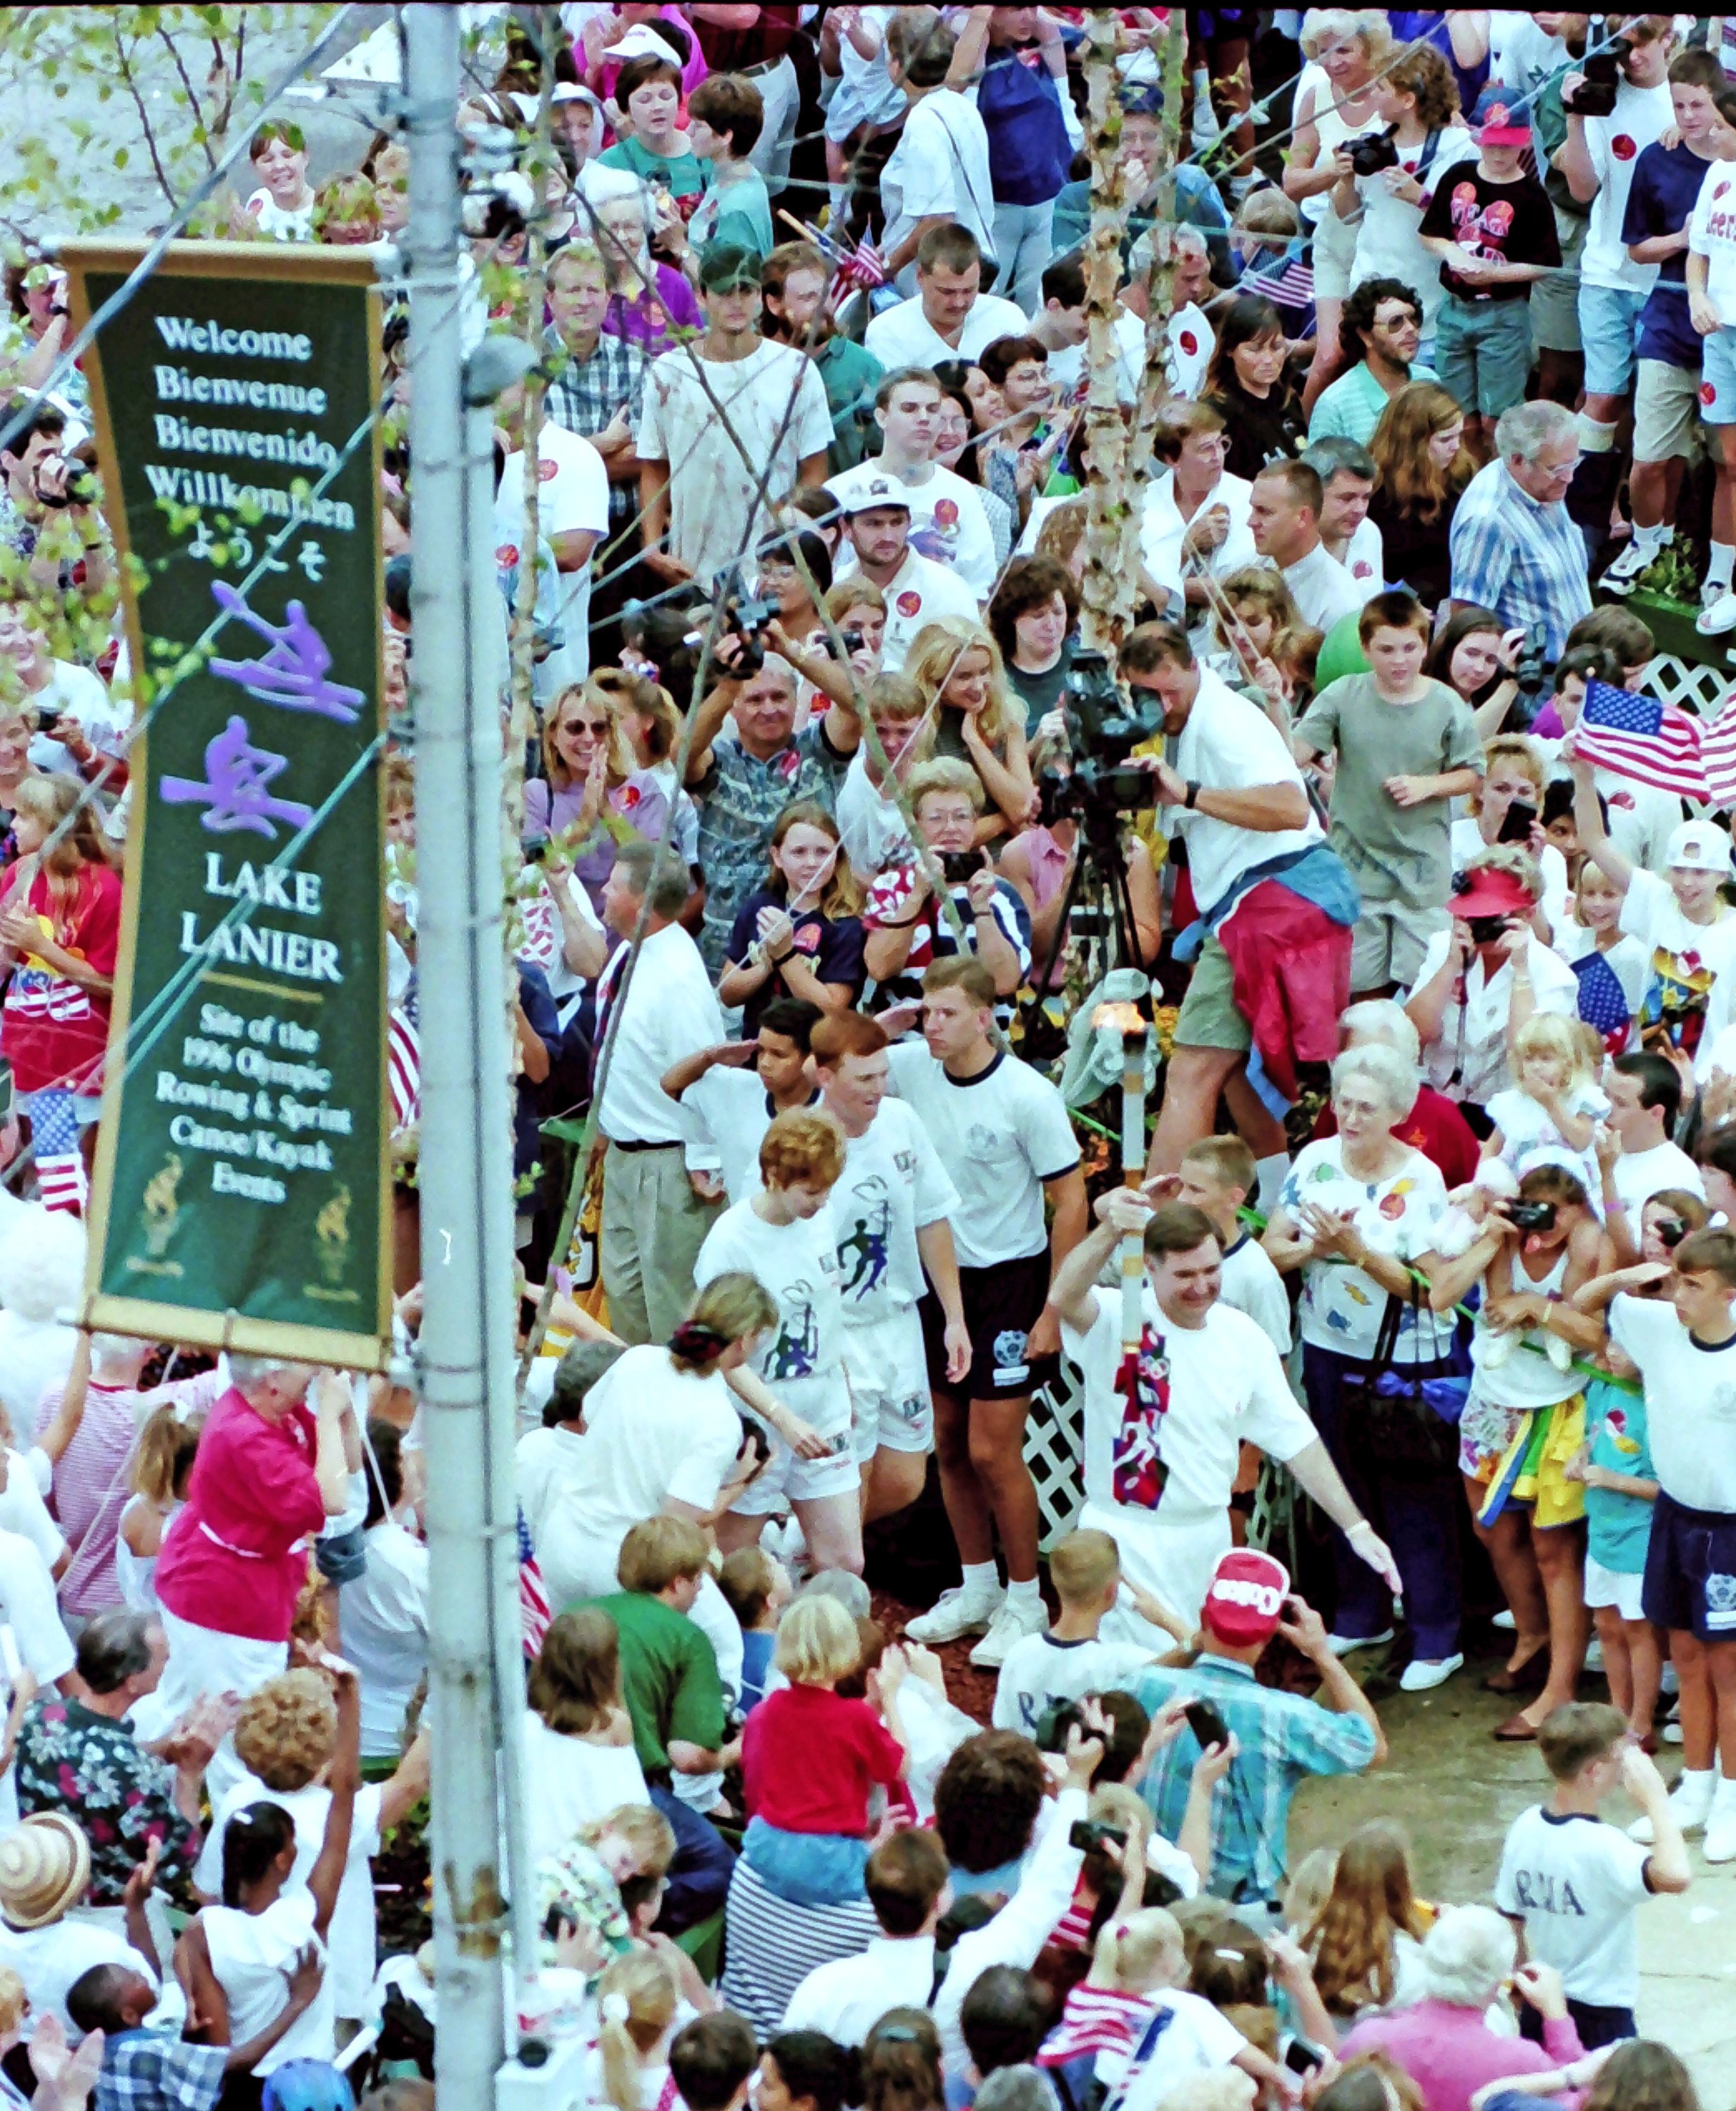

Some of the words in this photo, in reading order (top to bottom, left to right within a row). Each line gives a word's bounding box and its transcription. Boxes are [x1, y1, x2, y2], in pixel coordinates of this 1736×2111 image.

[154, 316, 314, 362] Welcome
[153, 364, 328, 415] Bienvenue
[153, 414, 341, 473] Bienvenido
[204, 851, 322, 915] LAKE
[179, 911, 344, 984] LANIER
[200, 1003, 245, 1039] Site
[248, 1015, 277, 1044] of
[277, 1021, 320, 1054] the
[183, 1036, 232, 1072] 1996
[236, 1046, 332, 1092] Olympic
[156, 1070, 250, 1122] Rowing
[253, 1091, 273, 1121] &
[279, 1095, 352, 1135] Sprint
[169, 1114, 251, 1158] Canoe
[255, 1129, 334, 1172] Kayak
